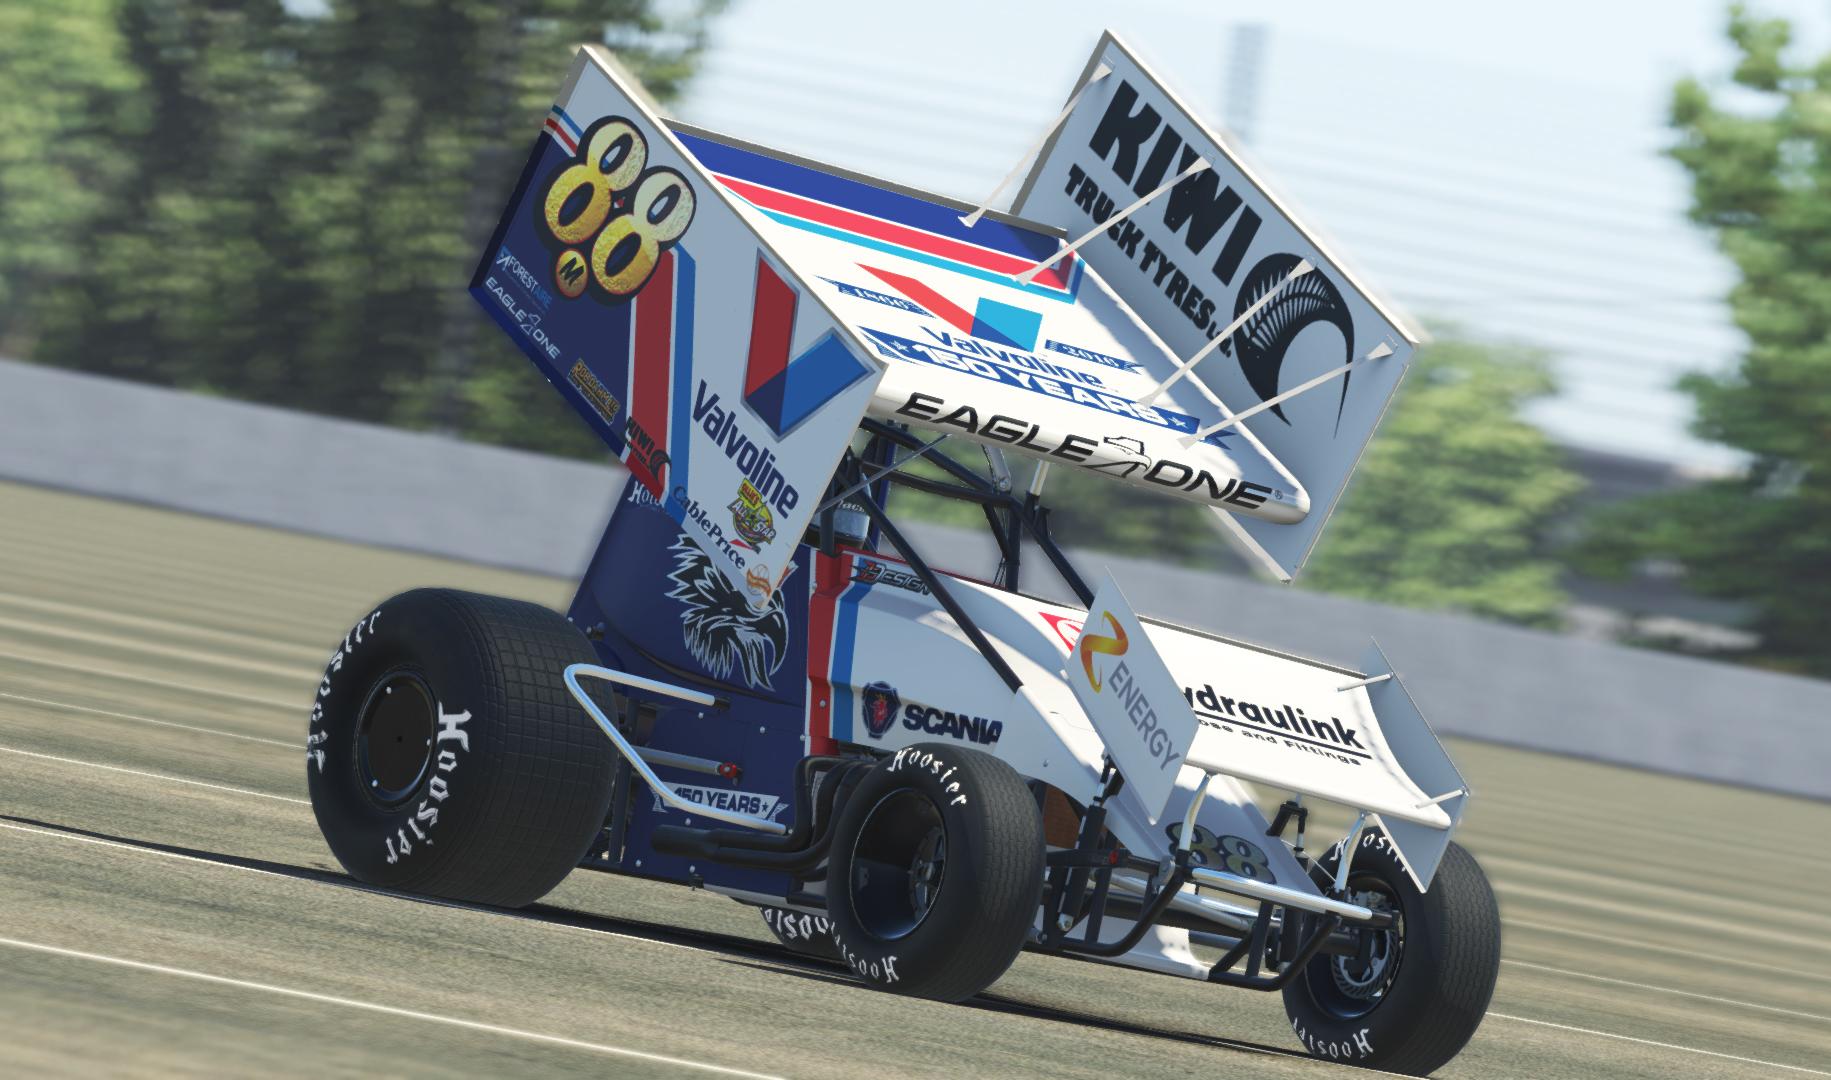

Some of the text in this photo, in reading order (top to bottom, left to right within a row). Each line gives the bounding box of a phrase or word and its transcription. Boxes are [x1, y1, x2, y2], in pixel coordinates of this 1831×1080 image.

[538, 118, 697, 298] 88
[1088, 79, 1263, 287] KIWI
[559, 256, 586, 287] M
[1064, 162, 1146, 260] TRUCK
[1138, 239, 1217, 331] TYRES
[485, 276, 528, 323] EAGLE
[532, 328, 561, 360] ONE
[918, 325, 1105, 389] Valvoline
[912, 343, 1170, 426] 150 YEARS
[692, 378, 800, 520] Valvoline
[896, 391, 1273, 510] EAGLE ONE
[673, 485, 747, 570] CablePrice
[902, 703, 1003, 745] SCANIA
[1108, 660, 1181, 771] ENERGY
[1184, 683, 1358, 750] draulink
[1198, 719, 1362, 766] ose and Fittings
[705, 790, 762, 815] YEARS
[887, 746, 967, 808] Hoosier
